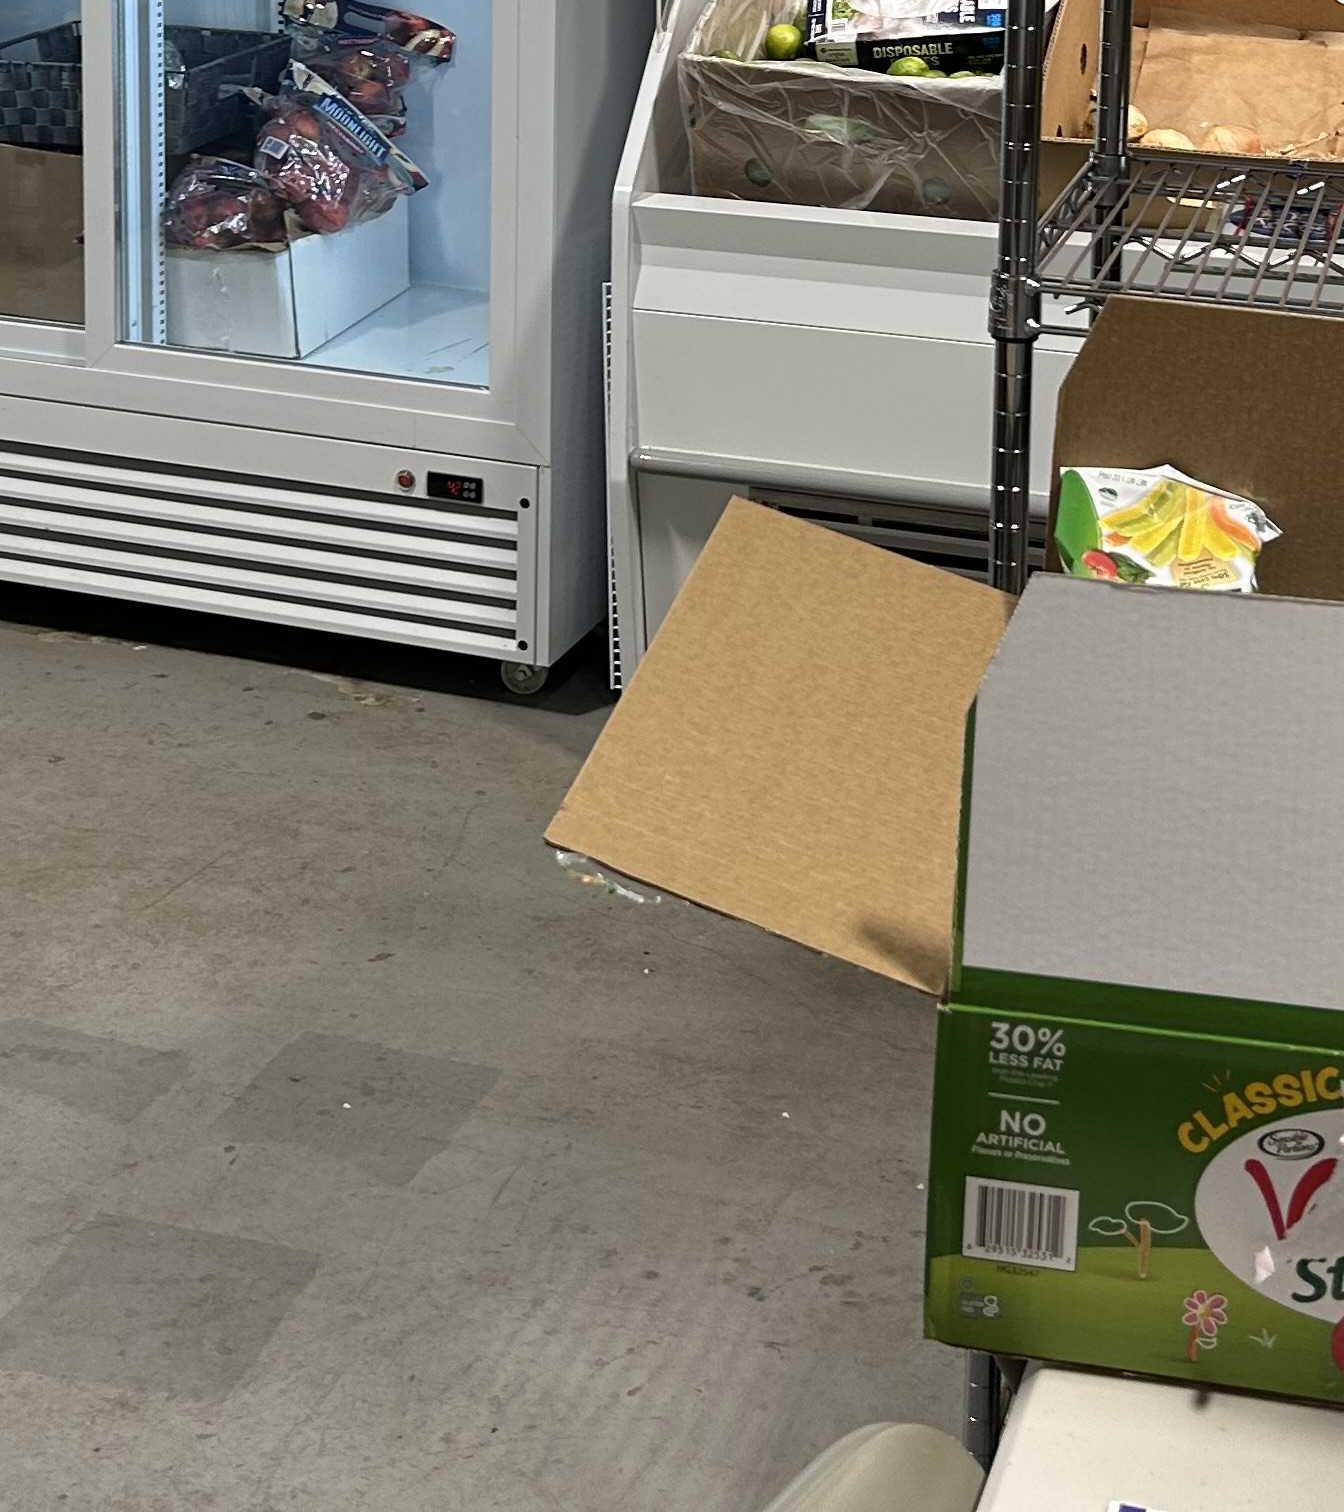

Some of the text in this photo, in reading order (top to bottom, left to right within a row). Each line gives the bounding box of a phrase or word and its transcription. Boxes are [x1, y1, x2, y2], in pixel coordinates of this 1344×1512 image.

[872, 42, 954, 59] DISPOSABLE
[319, 97, 388, 160] MOONLIGHT
[989, 1020, 1067, 1057] 30%
[988, 1050, 1065, 1072] LESS FAT
[999, 1109, 1047, 1137] NO
[1177, 1066, 1343, 1154] CLASSIC
[975, 1133, 1066, 1155] ARTIFICIAL
